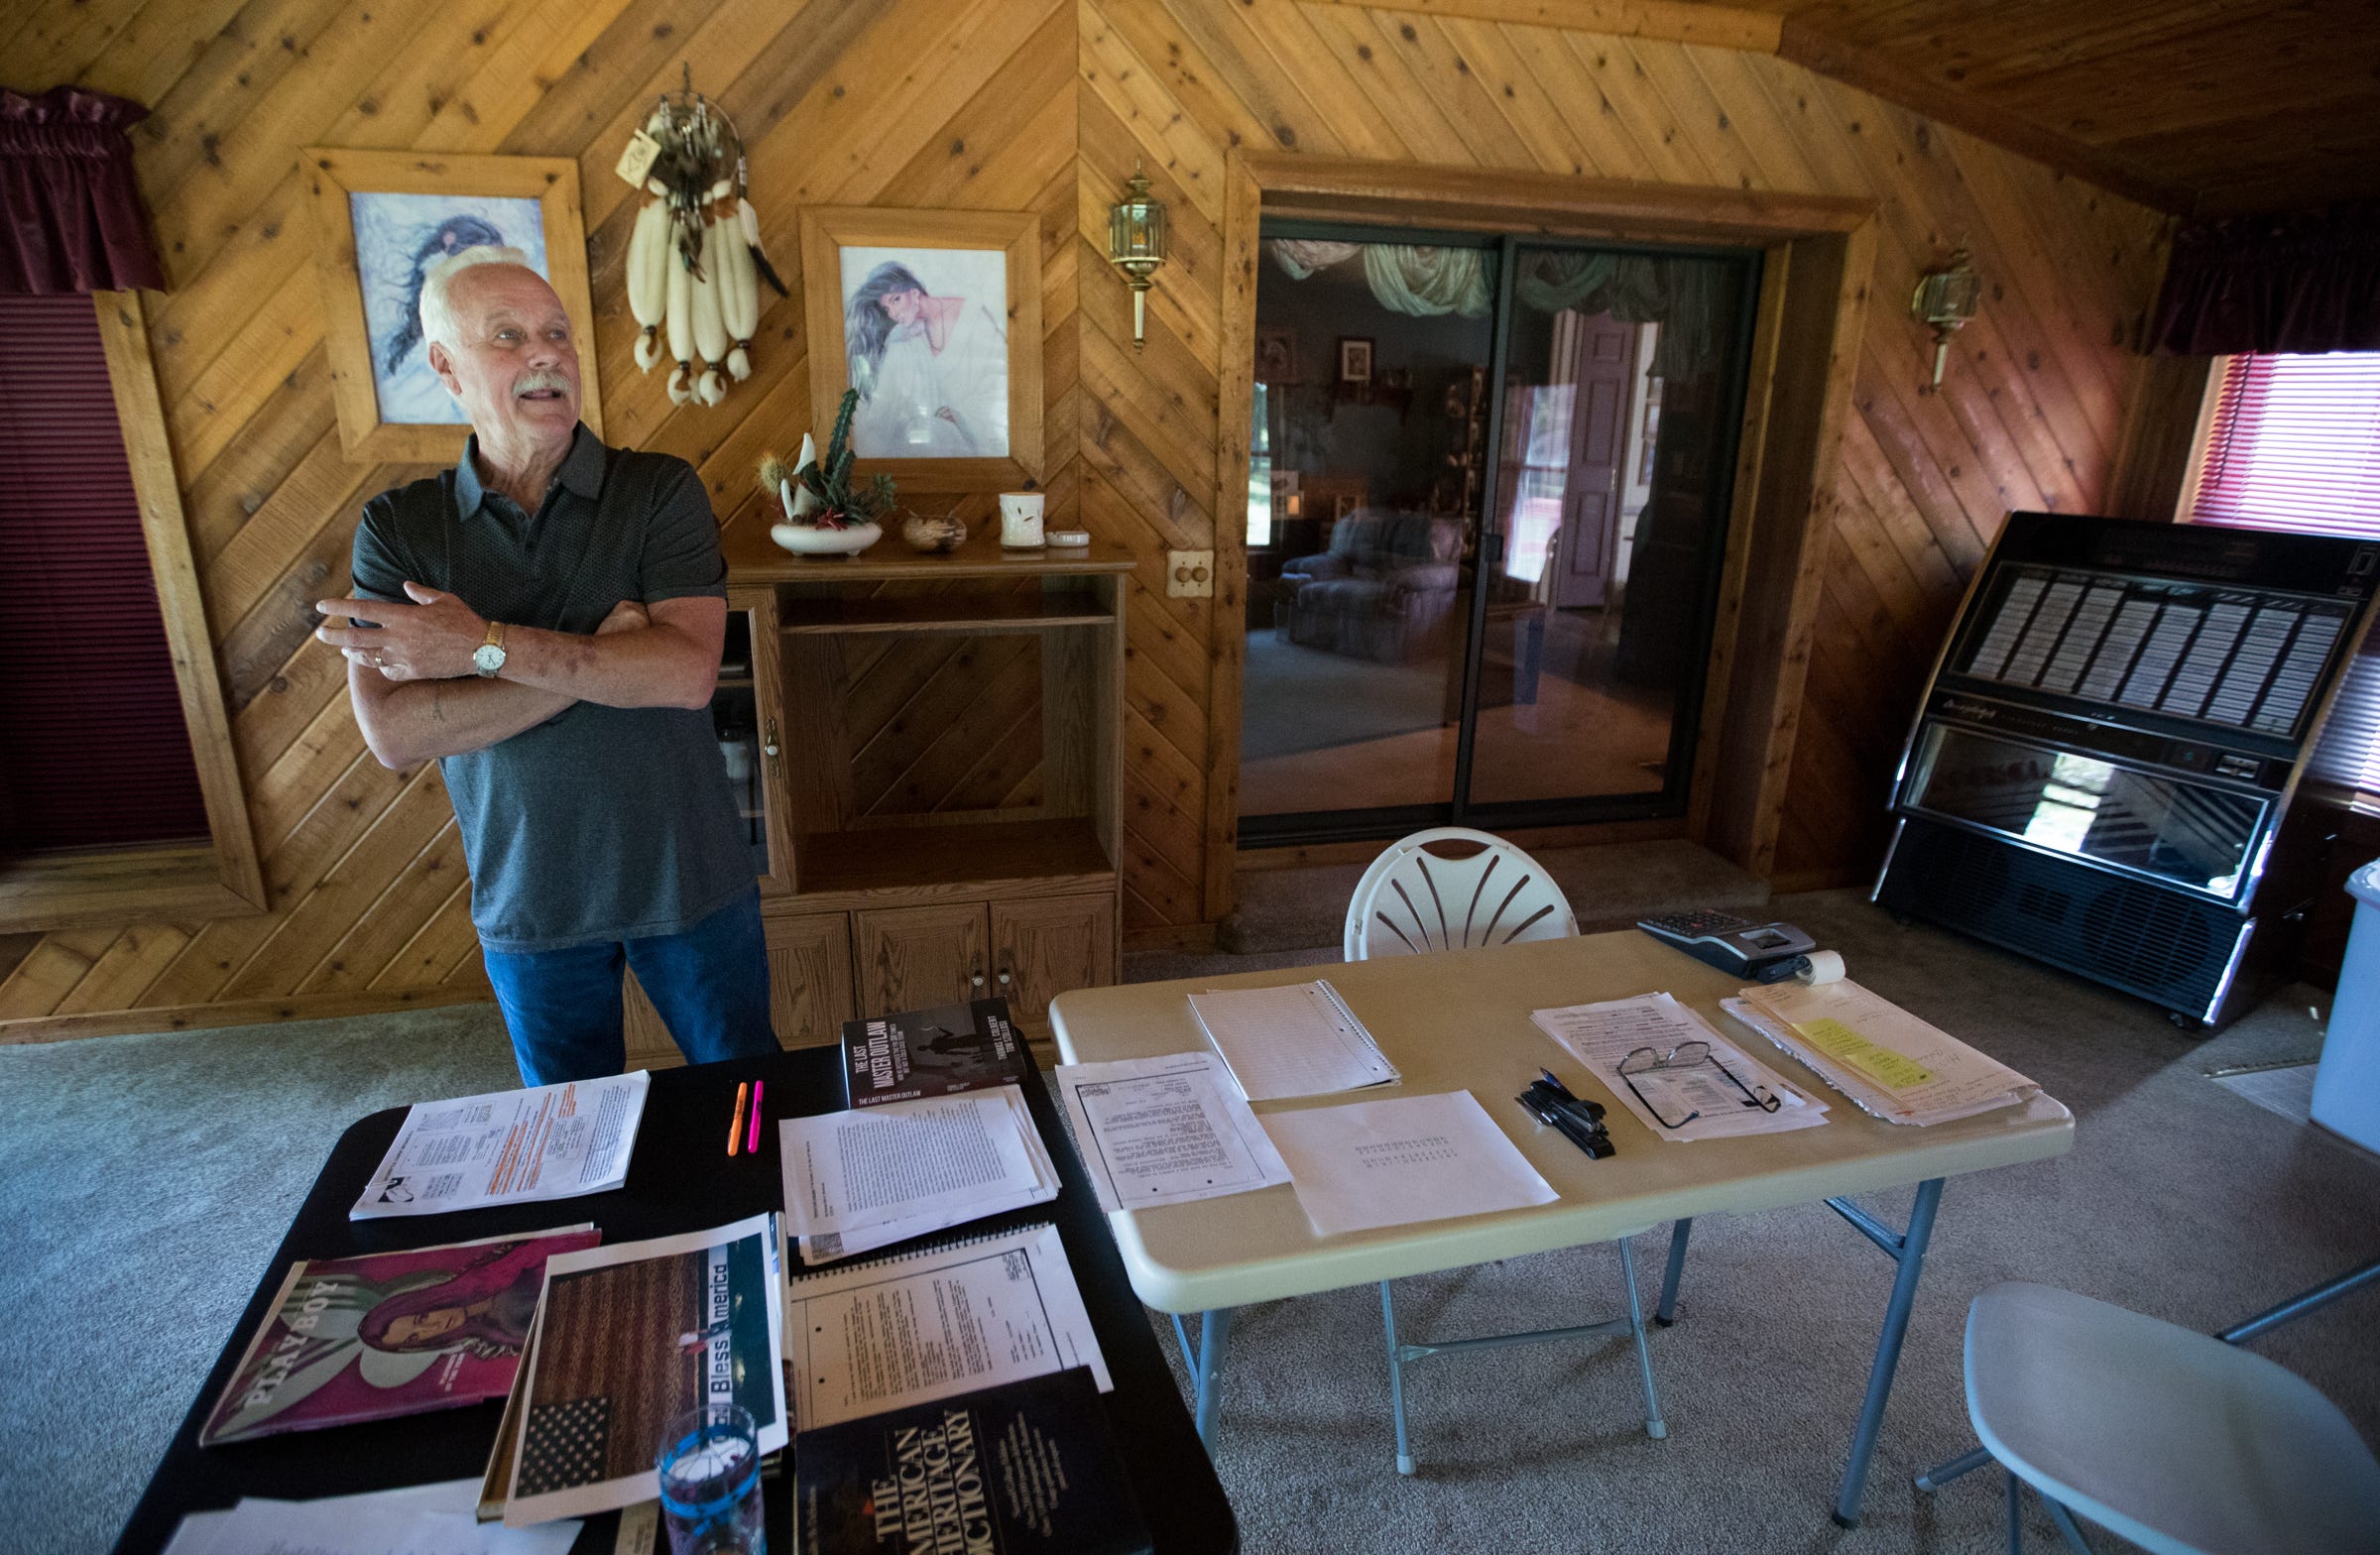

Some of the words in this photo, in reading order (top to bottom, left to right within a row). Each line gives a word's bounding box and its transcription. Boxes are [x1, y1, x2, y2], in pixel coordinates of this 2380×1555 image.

[867, 1021, 890, 1056] OUTLAW
[988, 1016, 1001, 1036] COLBERT
[854, 1045, 868, 1061] LAST
[855, 1060, 869, 1074] THE
[872, 1056, 894, 1088] MASTER
[881, 1093, 901, 1102] MASTER
[901, 1090, 921, 1099] OUTLAW
[709, 1264, 730, 1335] America
[244, 1281, 338, 1406] PLAYBOY
[711, 1340, 732, 1394] Bless
[895, 1426, 935, 1555] MERICAN
[944, 1409, 994, 1555] ICTIONARY
[872, 1475, 902, 1543] THE
